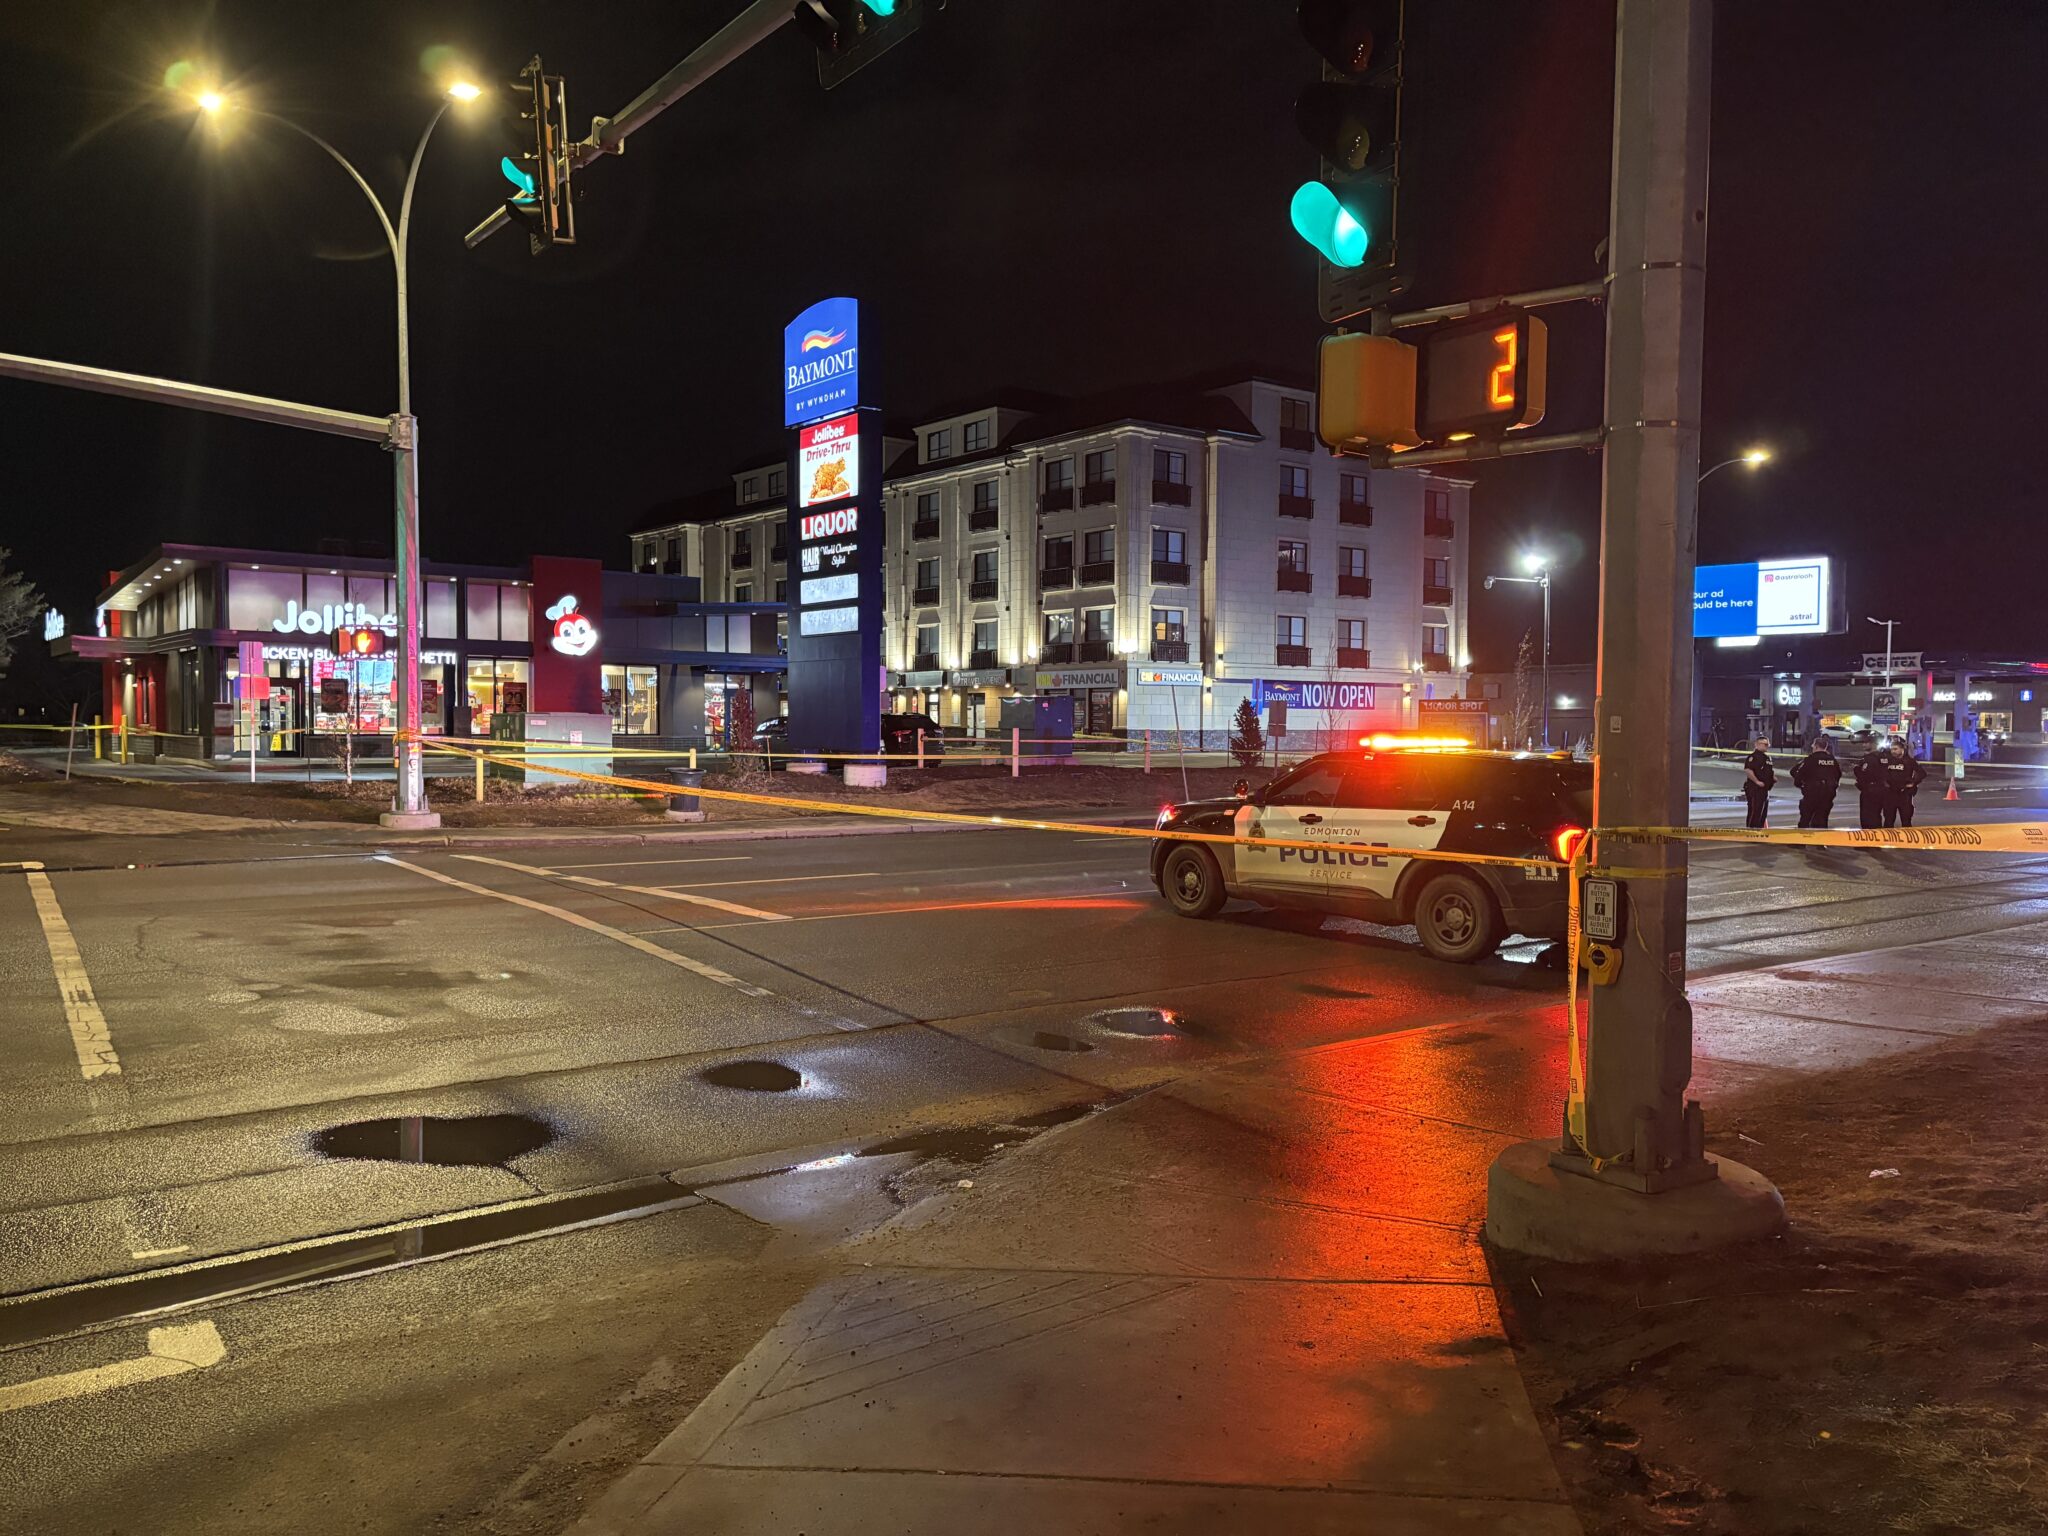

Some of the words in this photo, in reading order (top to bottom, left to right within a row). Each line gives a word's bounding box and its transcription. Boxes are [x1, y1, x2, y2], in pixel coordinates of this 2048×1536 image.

[788, 348, 856, 389] BAYMONT
[1491, 332, 1517, 404] 2
[797, 402, 805, 411] BY
[807, 388, 846, 407] WYNDHAM
[812, 424, 845, 444] Jollibee
[806, 441, 851, 462] Drive-Thru
[801, 508, 857, 541] LIQUOR
[802, 547, 819, 566] HAIR
[1711, 589, 1724, 598] ad
[1694, 601, 1713, 609] ould
[1716, 600, 1728, 608] be
[1731, 599, 1754, 607] here
[273, 601, 424, 637] Jollibe
[1062, 673, 1117, 685] FINANCIAL
[1161, 672, 1202, 682] FINANCIAL
[1265, 691, 1300, 701] BAYMONT
[1302, 684, 1337, 707] NOW
[1340, 685, 1374, 707] OPEN
[1424, 701, 1457, 711] LIQUOR
[1460, 701, 1484, 710] SPOT
[1452, 800, 1475, 811] A14
[1304, 827, 1361, 837] EDMONTON
[1942, 827, 1982, 845] CROSS
[1310, 869, 1352, 880] SERVICE
